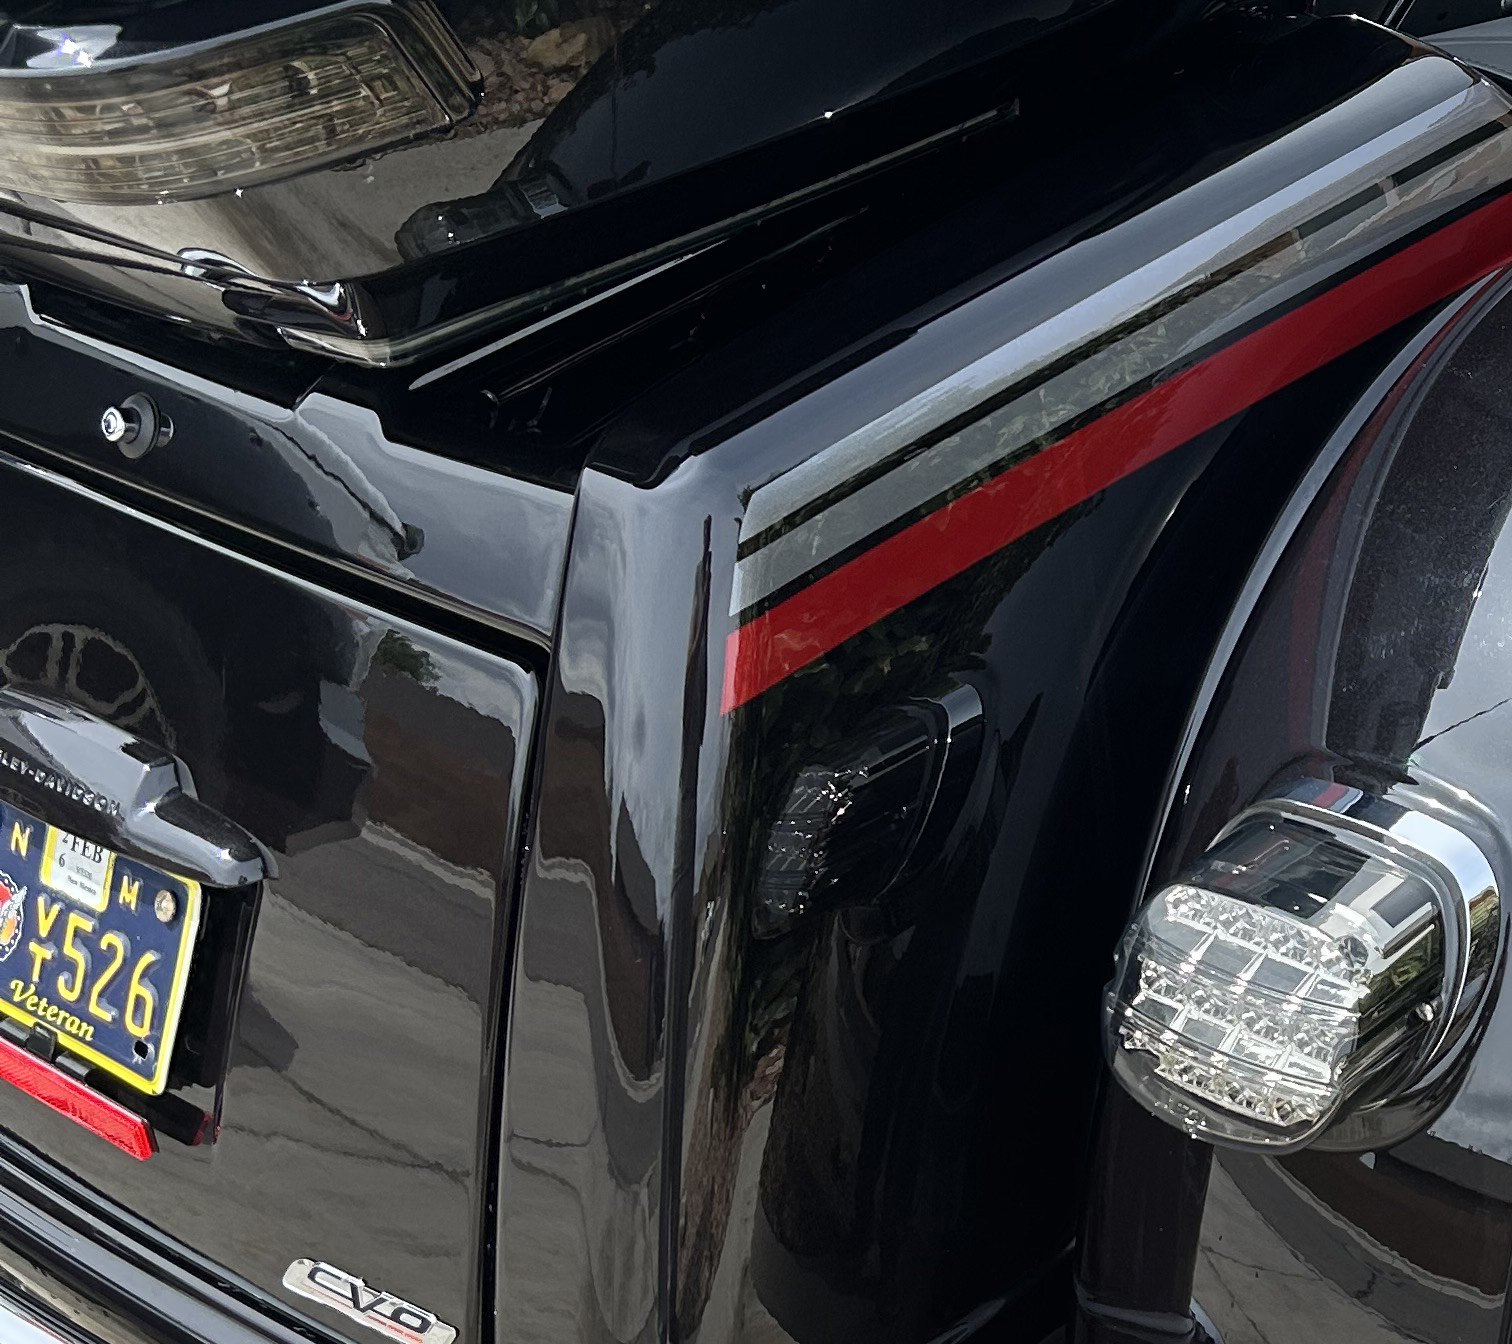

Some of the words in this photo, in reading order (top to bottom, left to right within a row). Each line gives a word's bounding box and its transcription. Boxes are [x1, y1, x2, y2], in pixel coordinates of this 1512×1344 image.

[0, 750, 120, 816] LEY-DAVIDSON
[11, 822, 31, 857] N
[119, 875, 140, 911] M
[70, 836, 104, 864] FEB
[57, 911, 157, 1038] 526
[10, 980, 95, 1041] Veteran
[307, 1263, 434, 1335] CVO
